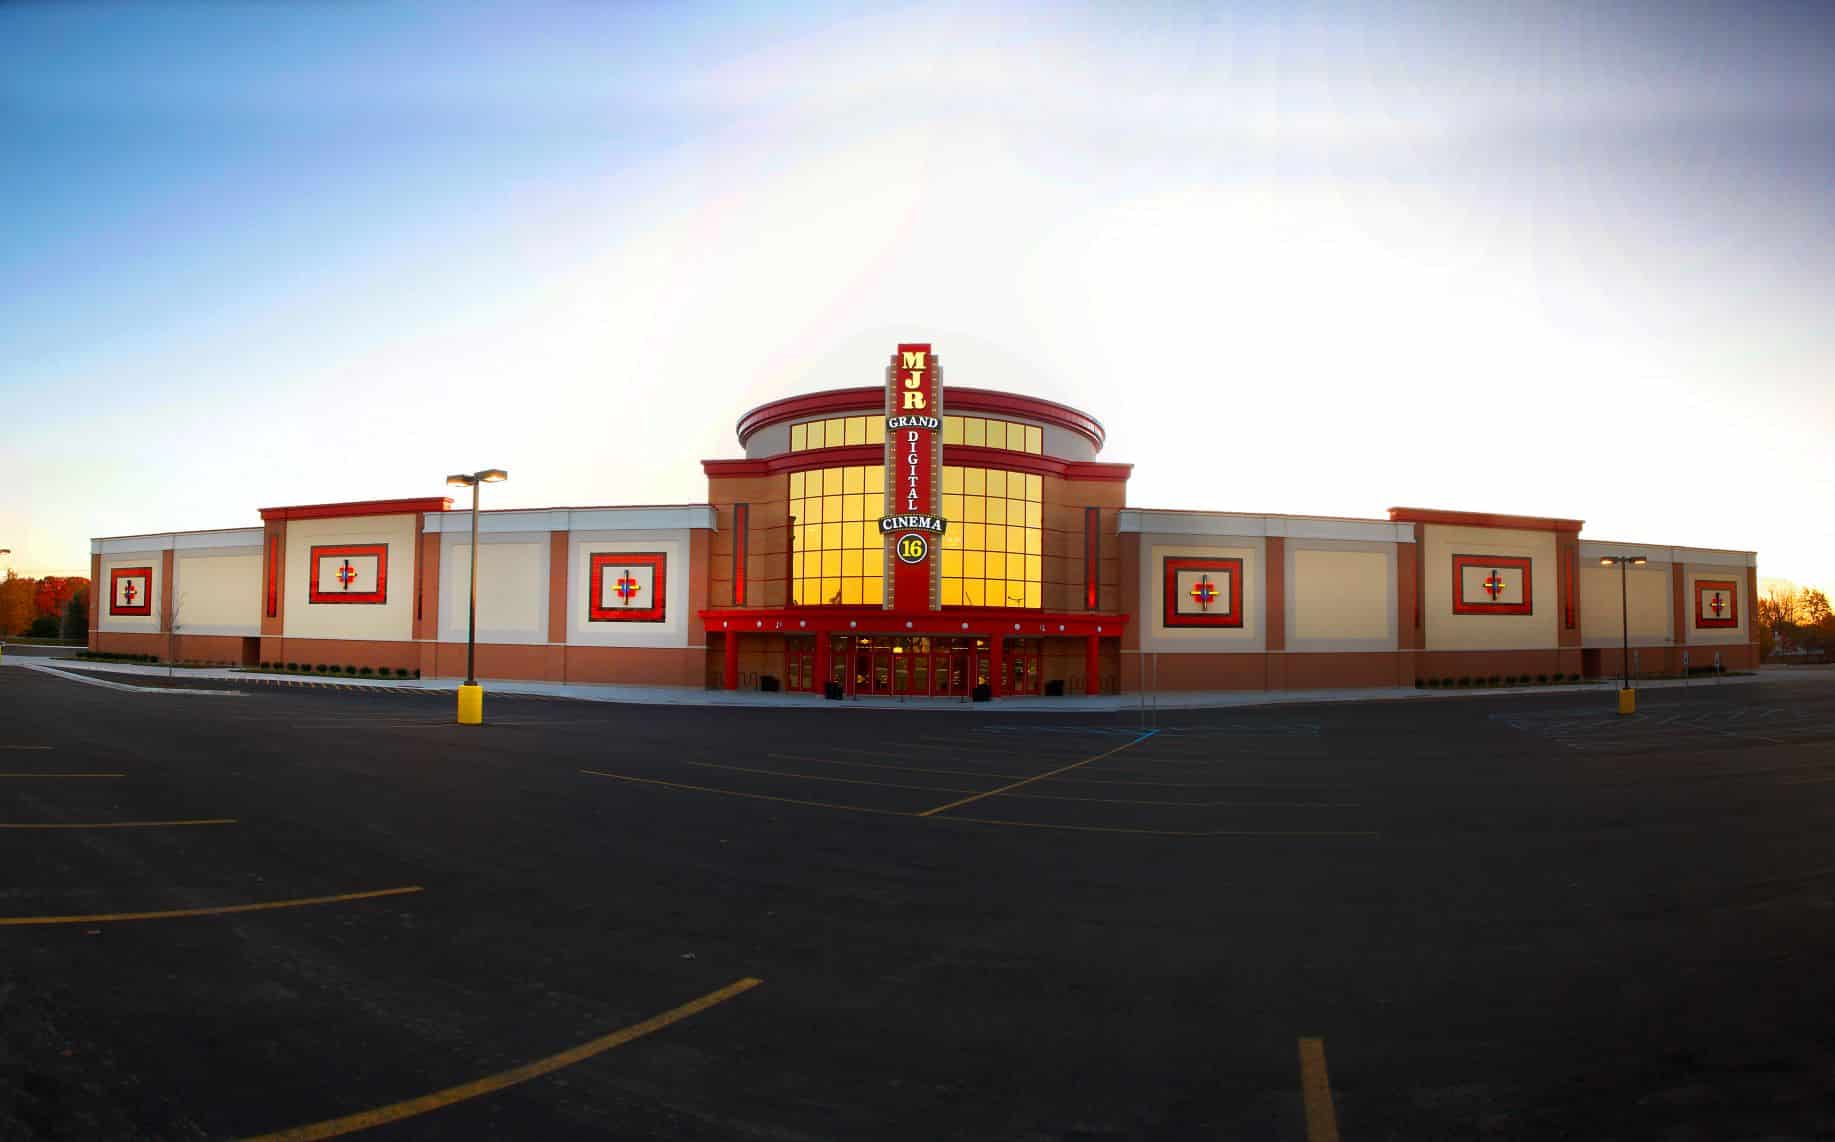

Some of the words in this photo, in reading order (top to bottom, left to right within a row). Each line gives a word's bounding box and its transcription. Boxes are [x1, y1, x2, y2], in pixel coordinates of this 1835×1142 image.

[902, 351, 927, 409] MJR
[888, 416, 938, 428] GRAND
[907, 431, 919, 510] DIGITAL
[882, 516, 942, 530] CINEMA
[902, 539, 922, 557] 16
